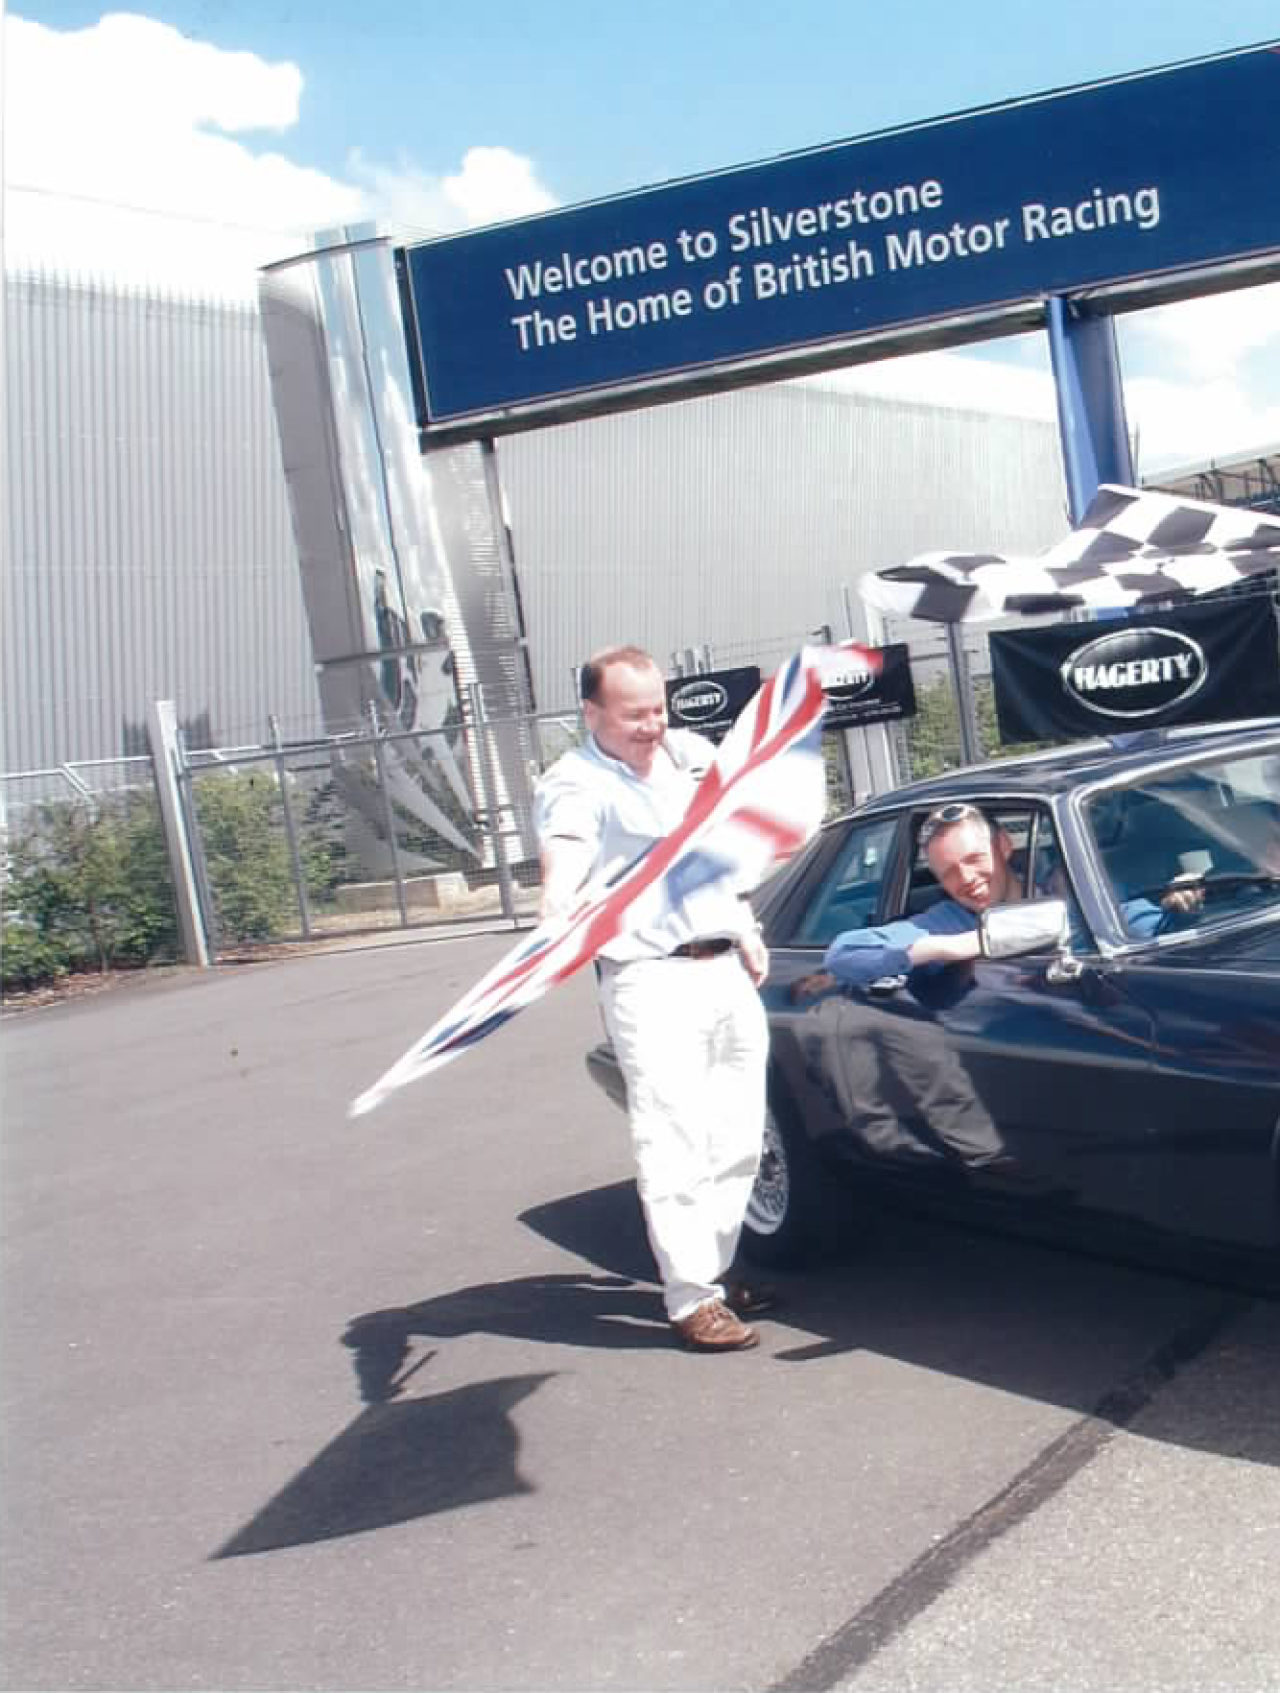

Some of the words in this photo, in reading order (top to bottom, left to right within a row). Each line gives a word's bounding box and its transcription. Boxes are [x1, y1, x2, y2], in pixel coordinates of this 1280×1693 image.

[504, 242, 668, 300] Welcome
[677, 230, 718, 262] to
[728, 179, 943, 251] Silverstone
[511, 311, 577, 350] The
[586, 288, 692, 335] Home
[703, 265, 742, 309] of
[753, 240, 874, 299] British
[885, 217, 1010, 271] Motor
[1022, 187, 1160, 242] Racing
[1074, 652, 1193, 690] HAGERTY
